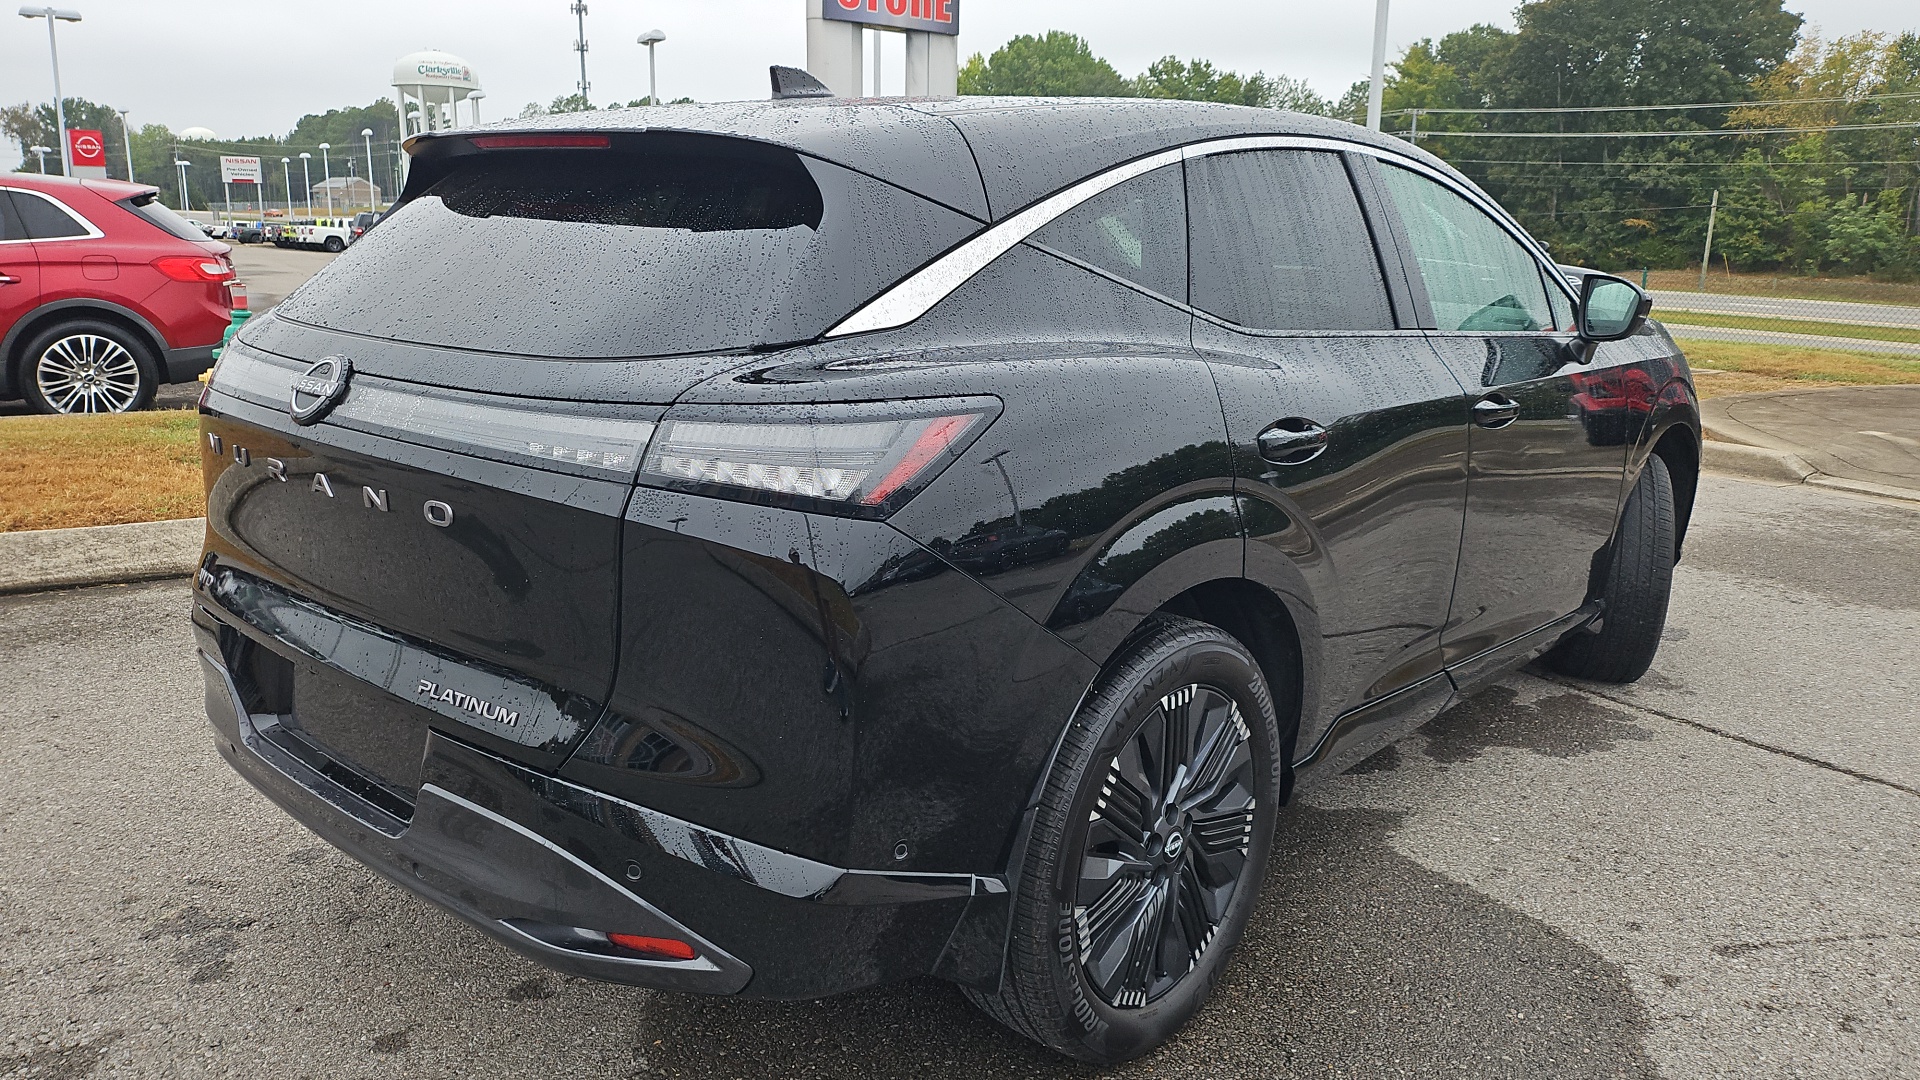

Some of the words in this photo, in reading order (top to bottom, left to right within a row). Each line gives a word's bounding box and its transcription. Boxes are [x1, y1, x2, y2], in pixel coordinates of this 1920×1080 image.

[418, 65, 462, 76] Clarksville
[199, 567, 214, 587] WD
[418, 679, 520, 727] PLATINUM
[1115, 661, 1179, 736] ALENZA
